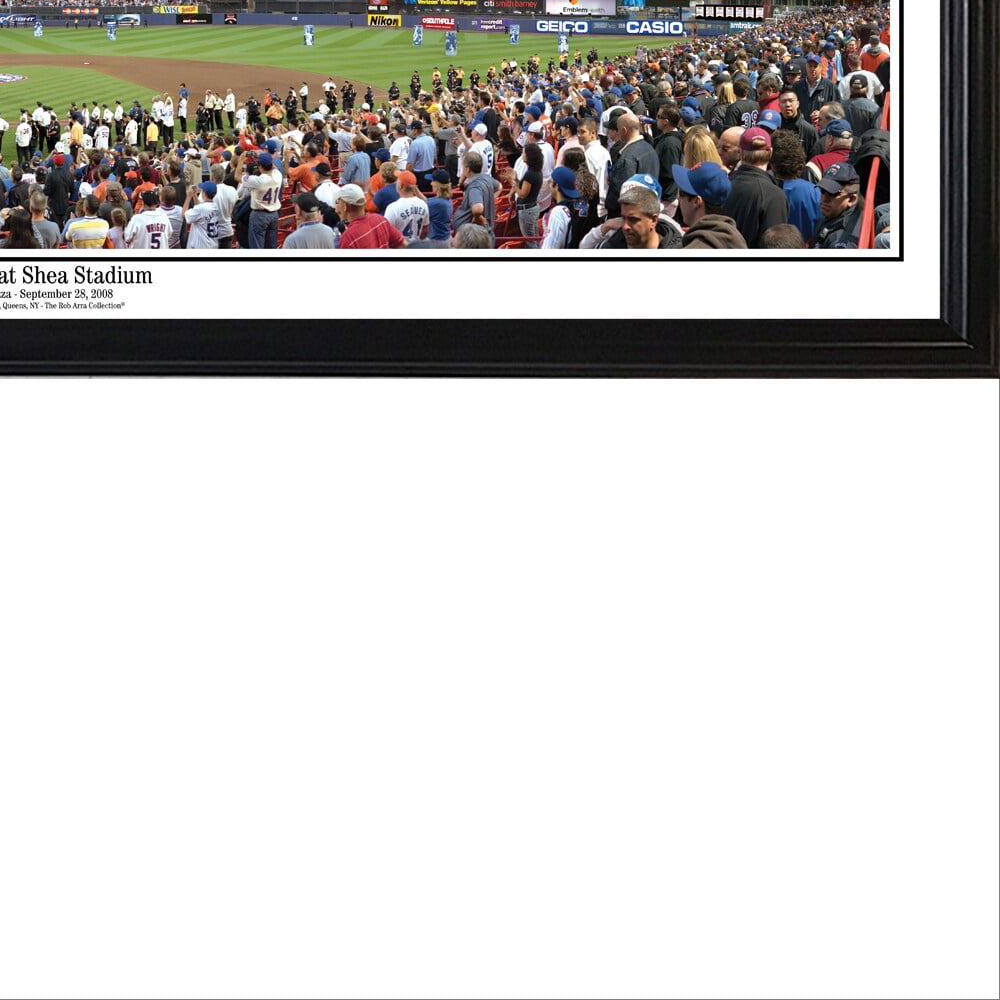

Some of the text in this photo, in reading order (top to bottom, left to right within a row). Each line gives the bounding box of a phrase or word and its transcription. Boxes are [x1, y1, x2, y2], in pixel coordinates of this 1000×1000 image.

[370, 16, 398, 26] Nikon
[536, 20, 588, 33] GEICO
[626, 21, 683, 34] CASIO
[262, 187, 278, 204] 41
[146, 223, 167, 233] WRIGHT
[402, 217, 423, 239] 41
[150, 233, 161, 249] 5
